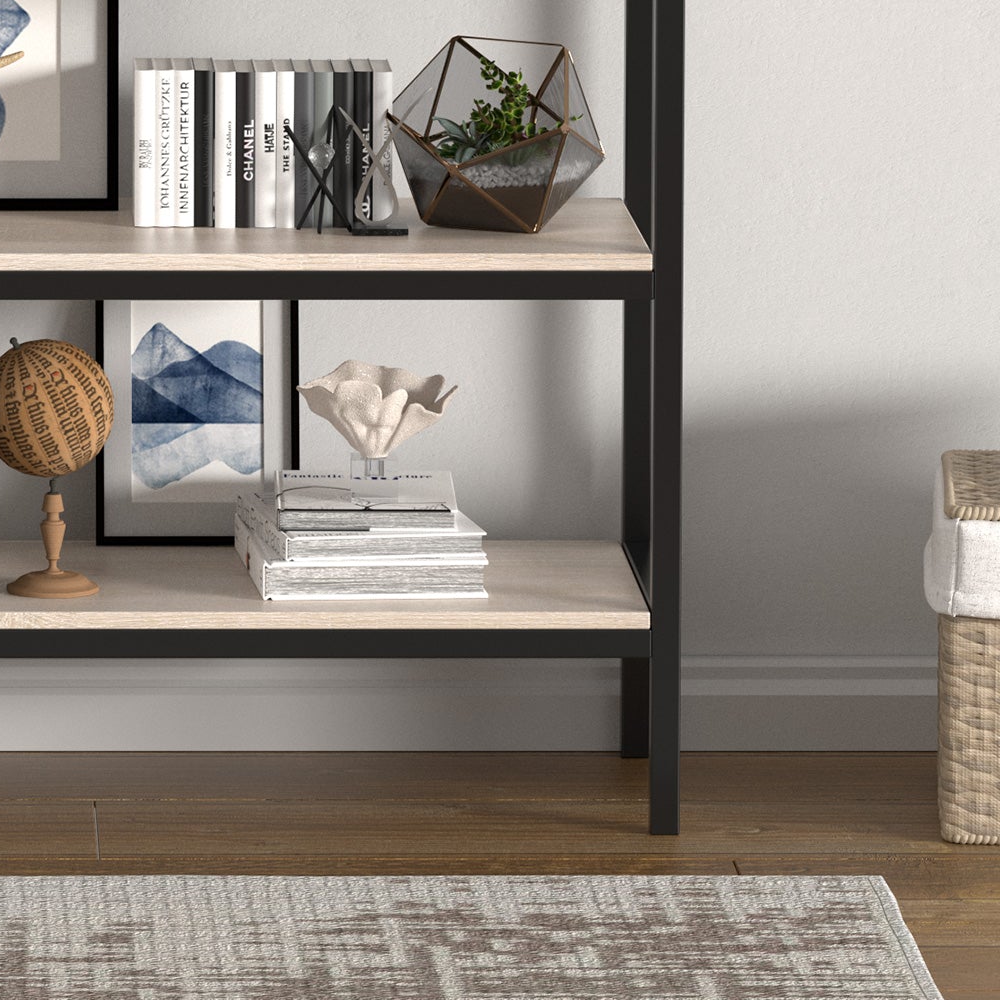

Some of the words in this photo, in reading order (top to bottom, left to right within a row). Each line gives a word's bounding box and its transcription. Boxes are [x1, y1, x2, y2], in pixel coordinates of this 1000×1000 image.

[178, 81, 190, 214] INNENARCHITEKTUR
[243, 119, 255, 182] CHANEL
[263, 123, 275, 153] HATJE
[282, 154, 290, 173] THE
[360, 122, 370, 178] HAEL
